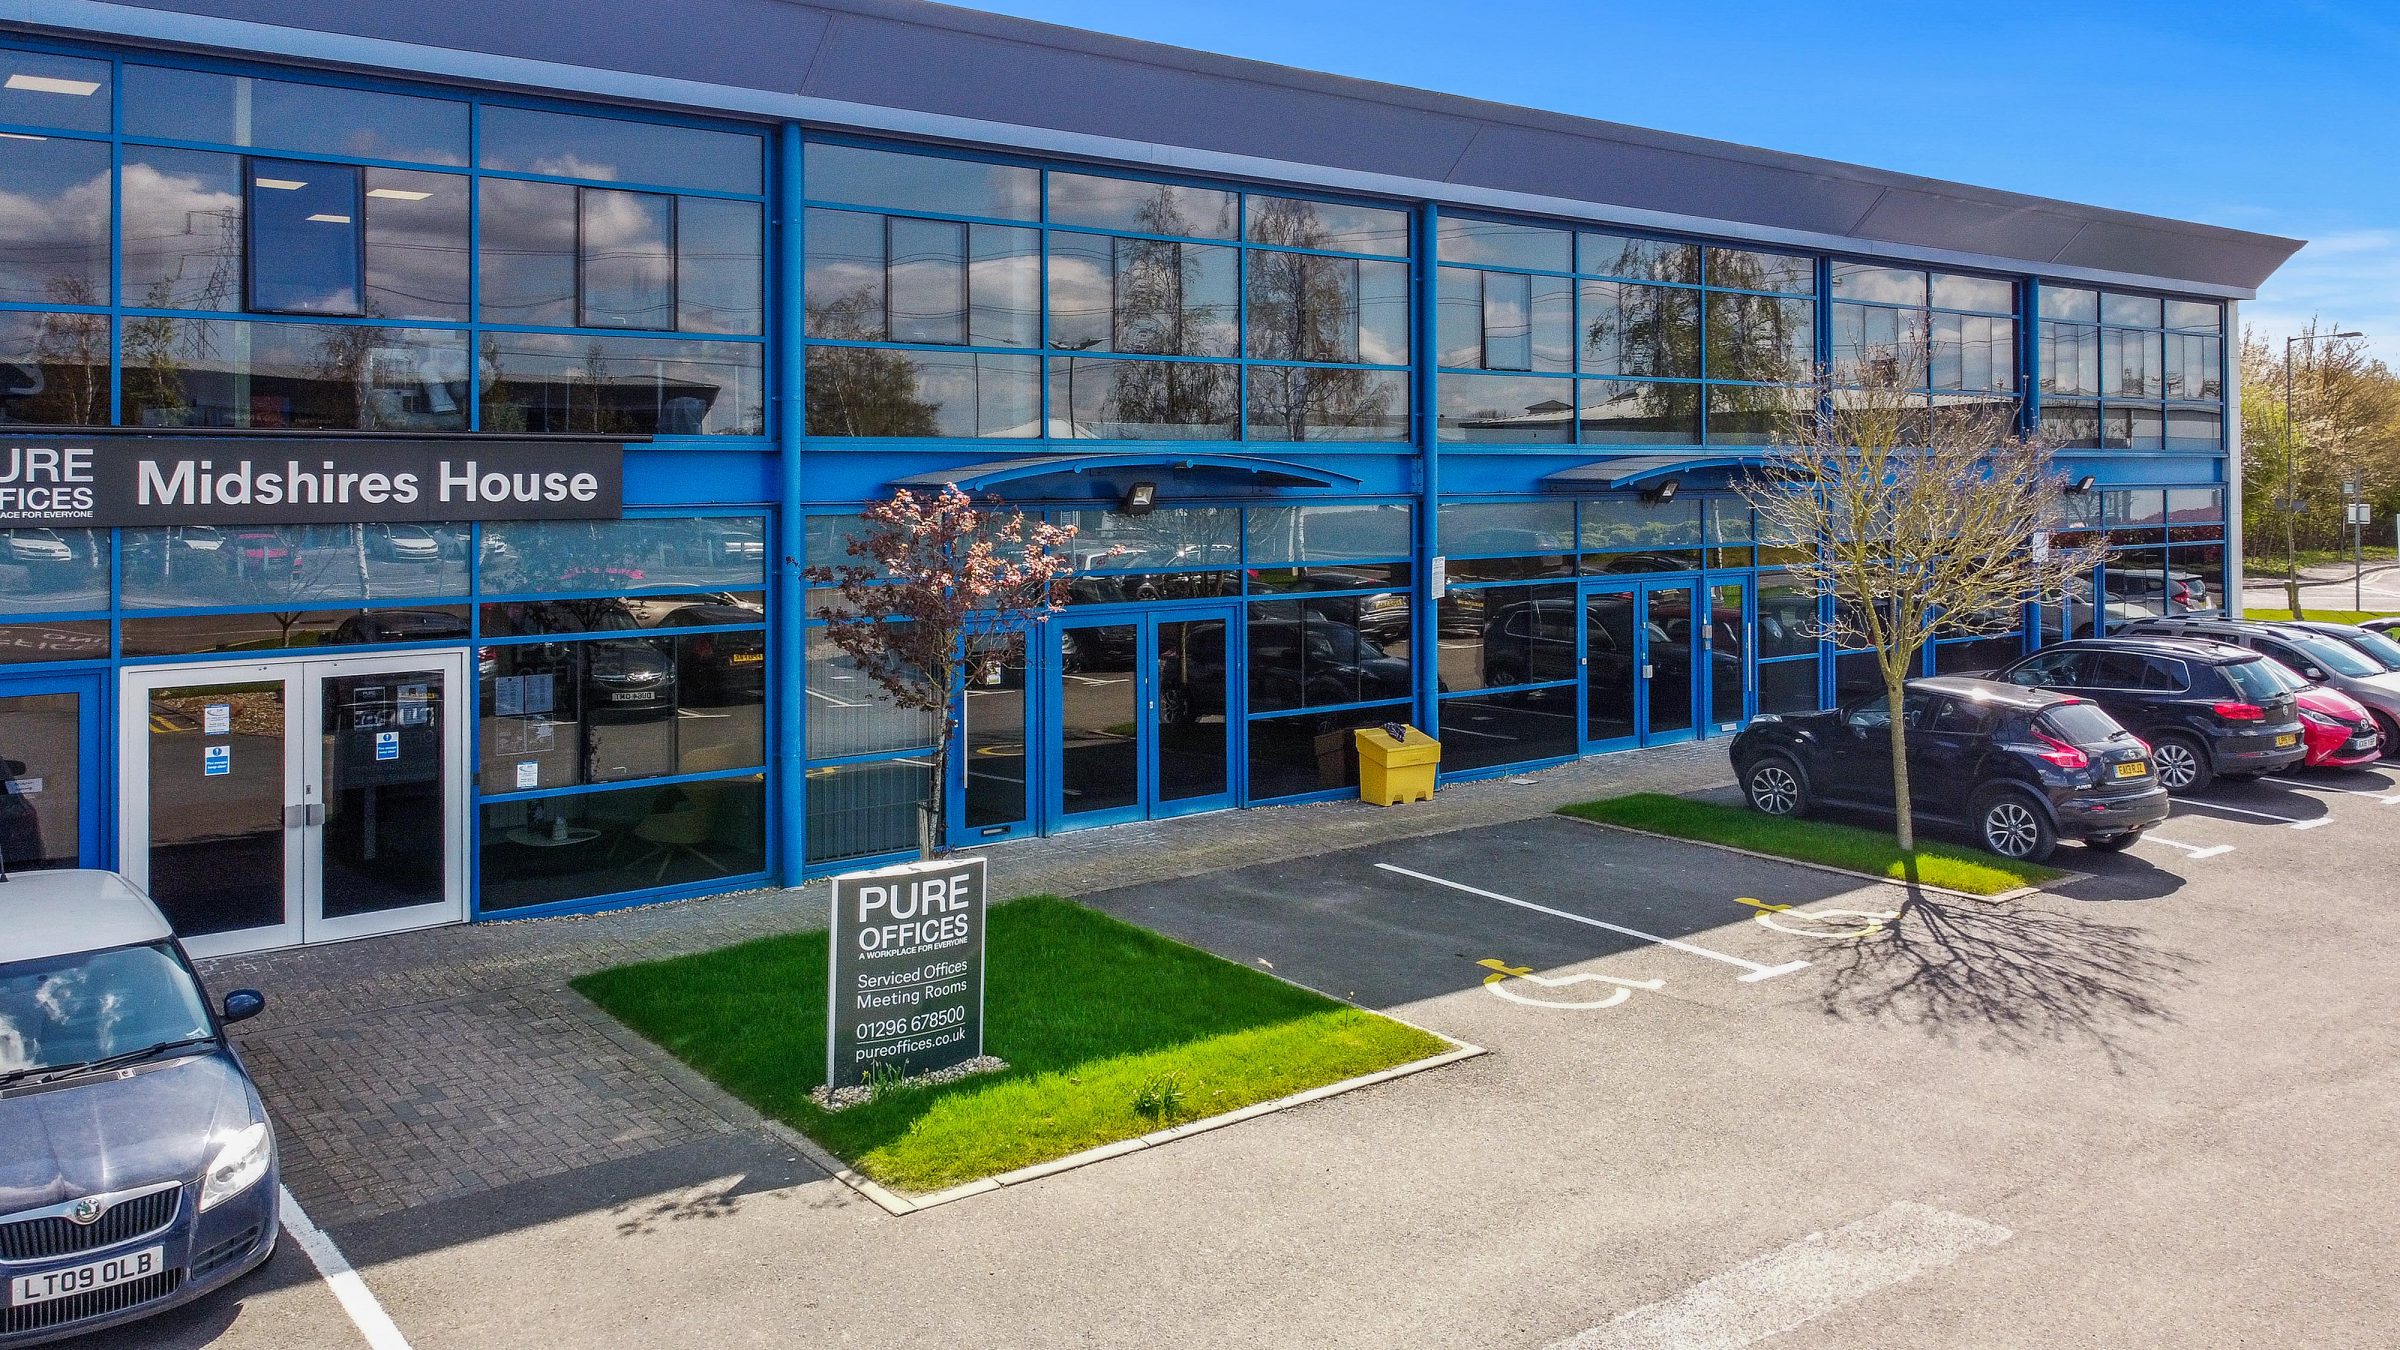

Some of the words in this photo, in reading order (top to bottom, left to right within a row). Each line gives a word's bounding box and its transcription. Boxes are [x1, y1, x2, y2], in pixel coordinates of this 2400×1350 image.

[0, 448, 94, 483] URE
[138, 460, 419, 505] Midshires
[439, 460, 599, 503] House
[0, 487, 94, 510] FICES
[44, 510, 94, 518] EVERYONE
[859, 873, 970, 923] PURE
[858, 913, 968, 951] OFFICES
[866, 946, 917, 959] WORKPLACE
[917, 943, 933, 953] FOR
[934, 936, 968, 950] EVERYONE
[858, 967, 920, 988] Serviced
[924, 960, 968, 979] Offices
[857, 989, 920, 1009] Meeting
[925, 980, 967, 1000] Rooms
[856, 1018, 907, 1040] 01296
[911, 1005, 965, 1032] 678500
[855, 1027, 966, 1063] pureoffices.co.uk
[24, 1269, 95, 1300] LT09
[103, 1252, 152, 1283] OLB
